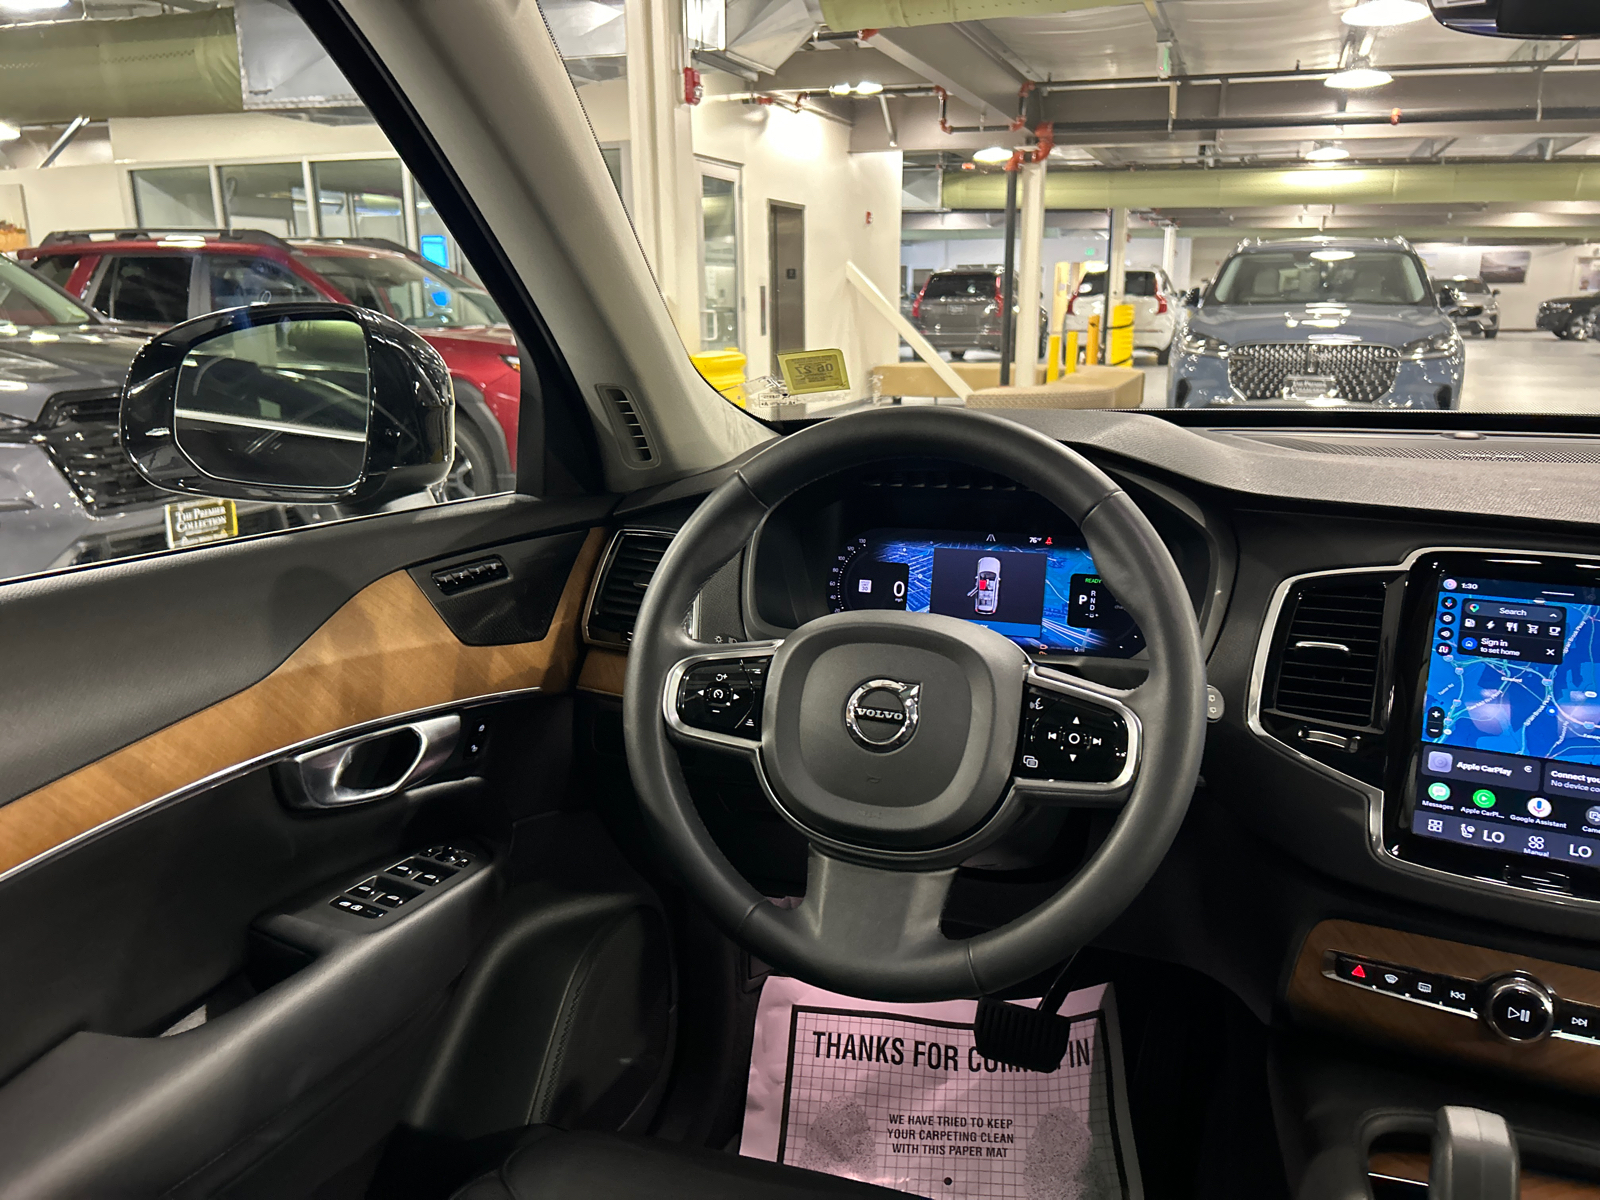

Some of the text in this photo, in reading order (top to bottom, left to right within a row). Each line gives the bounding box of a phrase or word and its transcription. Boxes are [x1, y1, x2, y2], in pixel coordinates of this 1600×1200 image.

[194, 506, 226, 519] PREMIER
[176, 515, 226, 532] COLLECTION
[894, 581, 905, 597] 0
[1461, 582, 1478, 590] 1:30
[1079, 595, 1088, 605] P
[1499, 607, 1527, 616] Search
[1481, 638, 1498, 647] Sign
[1500, 648, 1520, 656] home
[856, 708, 903, 720] VOLVO
[1456, 761, 1512, 777] Apple CarPlay
[1551, 770, 1585, 782] Connect
[1551, 779, 1562, 787] No
[1564, 781, 1588, 791] device
[1422, 800, 1454, 811] Messages
[1460, 806, 1480, 816] Apple
[1510, 814, 1567, 829] Google Assistant
[1483, 830, 1505, 843] LO
[1524, 848, 1550, 857] Manual
[1569, 844, 1592, 858] LO
[812, 1031, 905, 1065] THANKS
[912, 1040, 958, 1072] FOR
[1069, 1038, 1090, 1068] IN
[889, 1114, 1013, 1129] WE HAVE TRIED TO KEEP
[887, 1128, 1014, 1144] YOUR CARPETING CLEAN
[892, 1143, 1008, 1158] WITH THIS PAPER MAT
